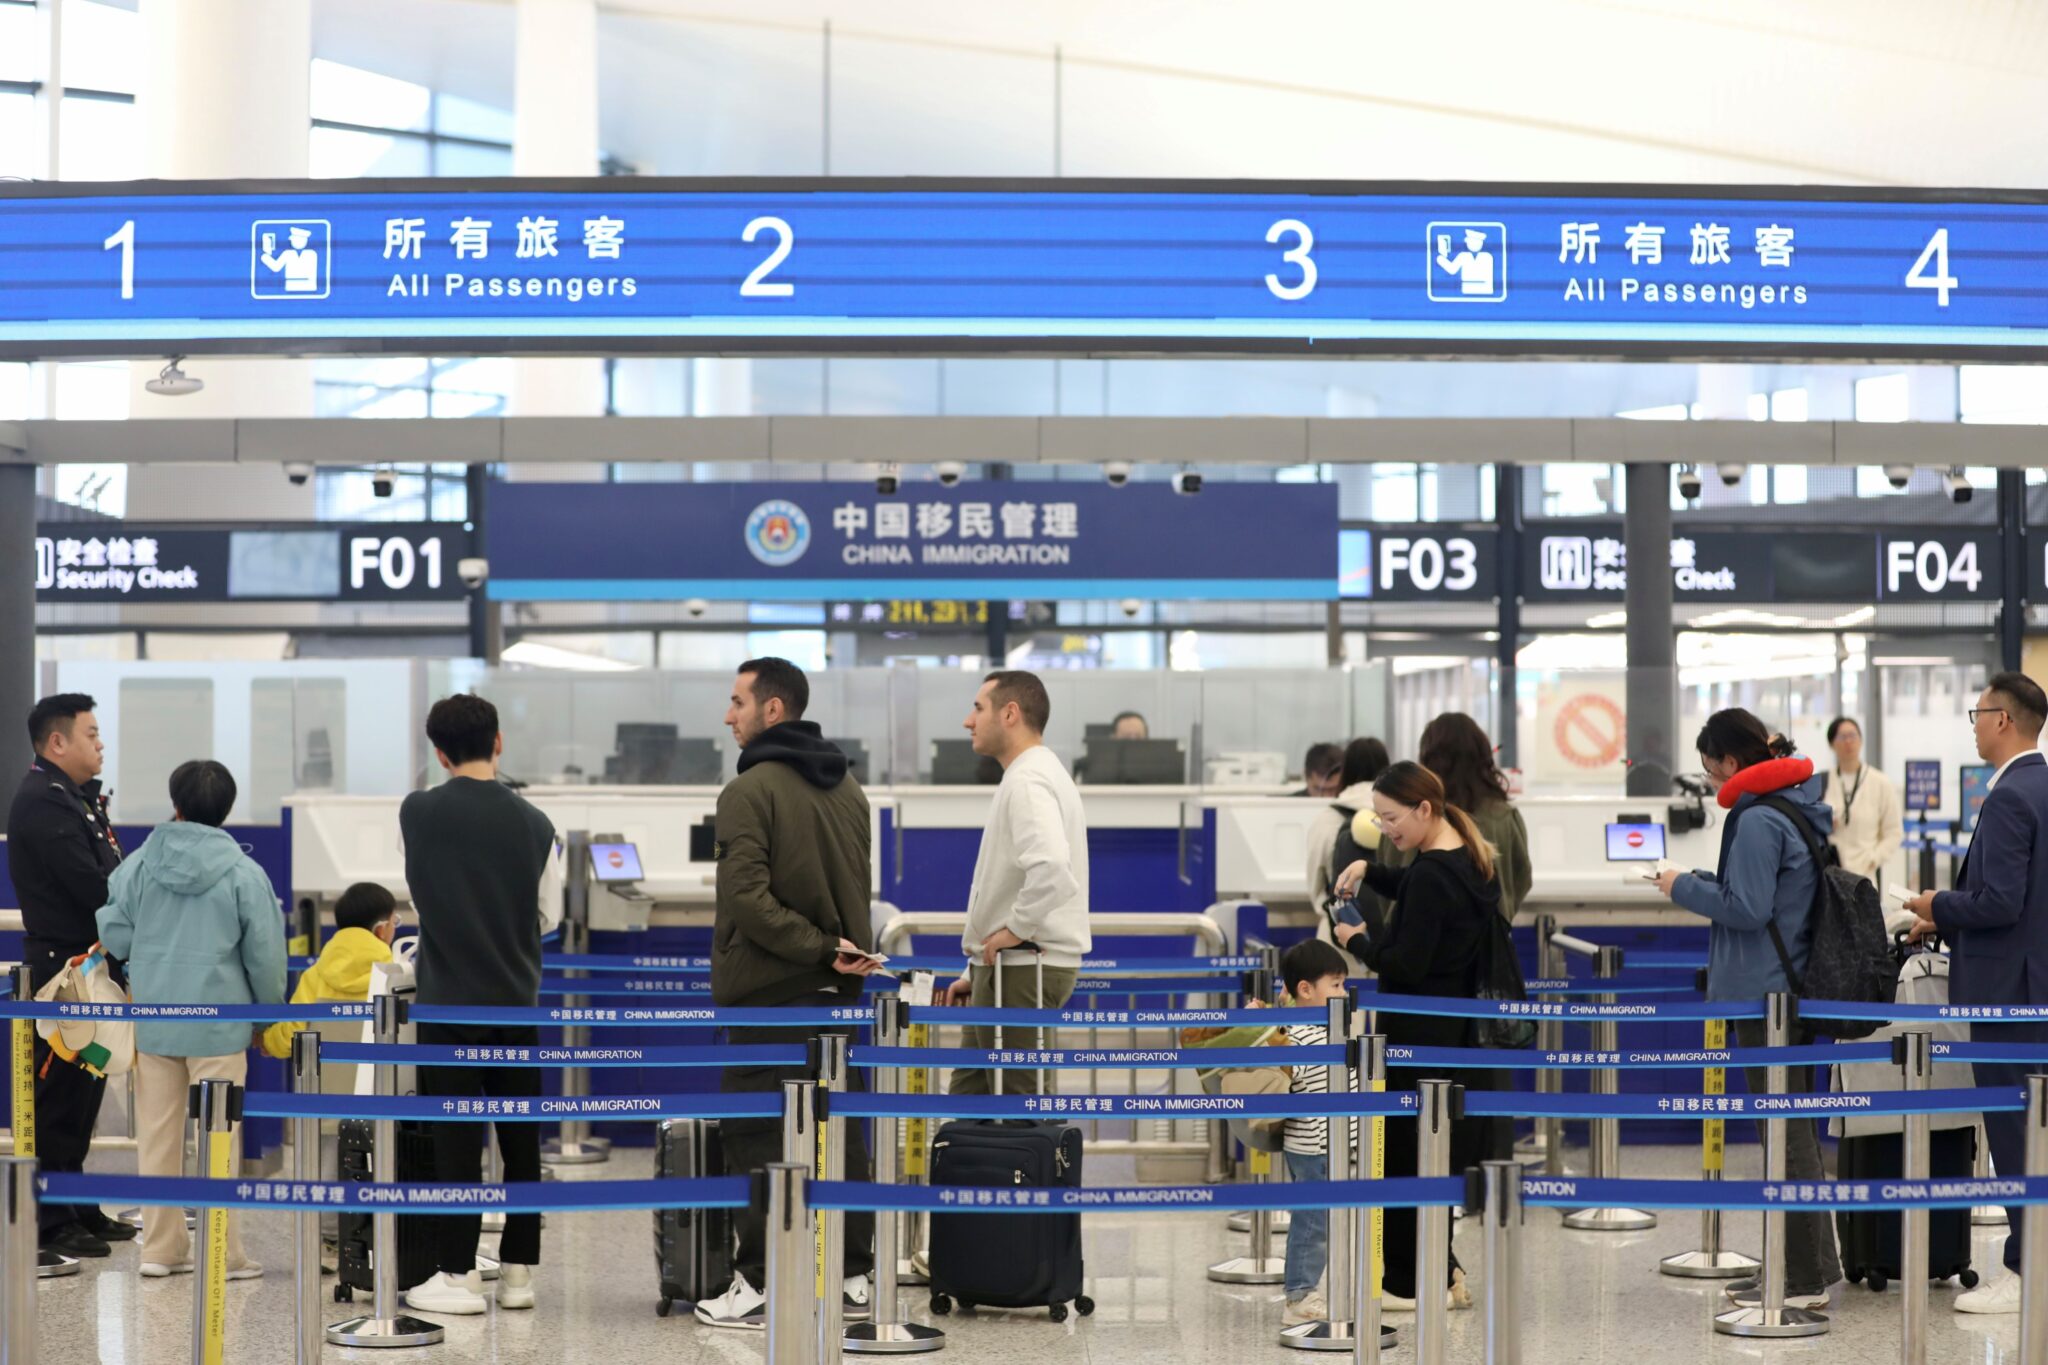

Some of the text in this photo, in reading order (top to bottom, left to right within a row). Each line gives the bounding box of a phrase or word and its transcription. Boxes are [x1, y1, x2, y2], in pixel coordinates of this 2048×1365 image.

[383, 216, 624, 259] 所有旅客
[1559, 223, 1793, 266] 所有旅客
[105, 221, 134, 299] 1
[740, 217, 793, 296] 2
[1266, 220, 1317, 300] 3
[1906, 229, 1958, 306] 4
[388, 274, 636, 301] All Passengers
[1564, 278, 1806, 308] All Passengers
[834, 502, 1077, 538] 中国移民管理
[56, 537, 158, 567] 安全检查
[843, 545, 1069, 564] CHINA IMMIGRATION
[351, 537, 440, 589] F01
[1381, 538, 1476, 590] F03
[1888, 541, 1981, 592] F04
[56, 565, 198, 593] Security Check
[1674, 566, 1736, 590] Check
[60, 1005, 217, 1015] 中国移民管理 CHINA IMMIGRATION
[332, 1005, 373, 1015] 中国移民
[551, 1010, 616, 1020] 中国移民管理
[625, 1011, 653, 1019] CHINA
[832, 1009, 874, 1018] 中国移民
[1062, 1012, 1227, 1022] 中国移民管理 CHINA IMMIGRATION
[1500, 1004, 1656, 1015] 中国移民管理 CHINA IMMIGRATION
[1940, 1008, 2002, 1016] 中国移民管理
[455, 1049, 641, 1060] 中国移民管理 CHINA IMMIGRATION
[988, 1052, 1064, 1063] 中国移民管理
[1110, 1053, 1177, 1061] IMMIGRATION
[1547, 1054, 1620, 1063] 中国移民管理
[1664, 1052, 1730, 1061] IMMIGRATION
[443, 1100, 660, 1113] 中国移民管理 CHINA IMMIGRATION
[1025, 1098, 1243, 1111] 中国移民管理 CHINA IMMIGRATION
[1659, 1097, 1870, 1111] 中国移民管理 CHINA IMMIGRATION
[238, 1184, 506, 1202] 中国移民管理 CHINA IMMIGRATION
[940, 1189, 1212, 1204] 中国移民管理 CHINA IMMIGRATION
[1523, 1182, 1575, 1195] RATION
[1764, 1182, 2025, 1201] 中国移民管理 CHINA IMMIGRATION
[214, 1246, 222, 1285] Distance
[213, 1288, 220, 1299] Of
